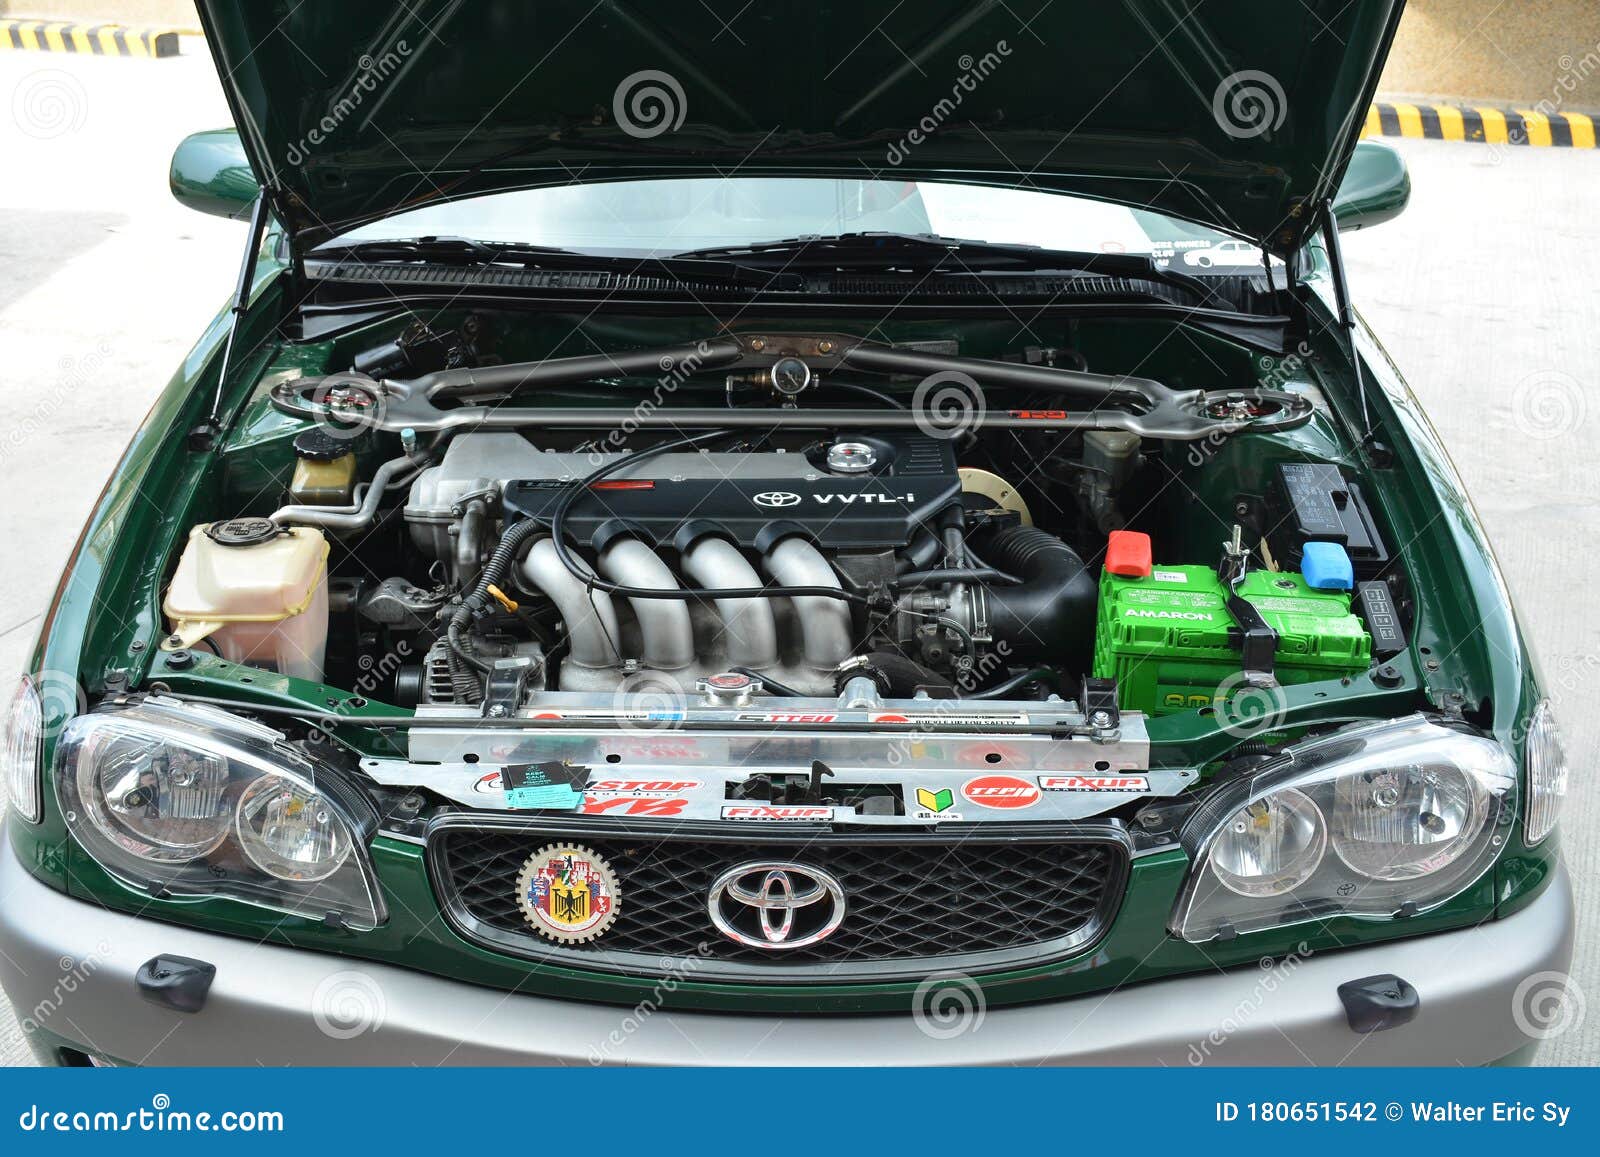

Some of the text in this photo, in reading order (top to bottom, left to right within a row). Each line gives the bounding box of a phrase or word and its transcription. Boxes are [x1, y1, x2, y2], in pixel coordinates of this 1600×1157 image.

[813, 493, 915, 504] VVTL-i
[1125, 608, 1213, 621] AMARON
[1046, 776, 1142, 790] FIXUP
[727, 806, 828, 819] FIXUP
